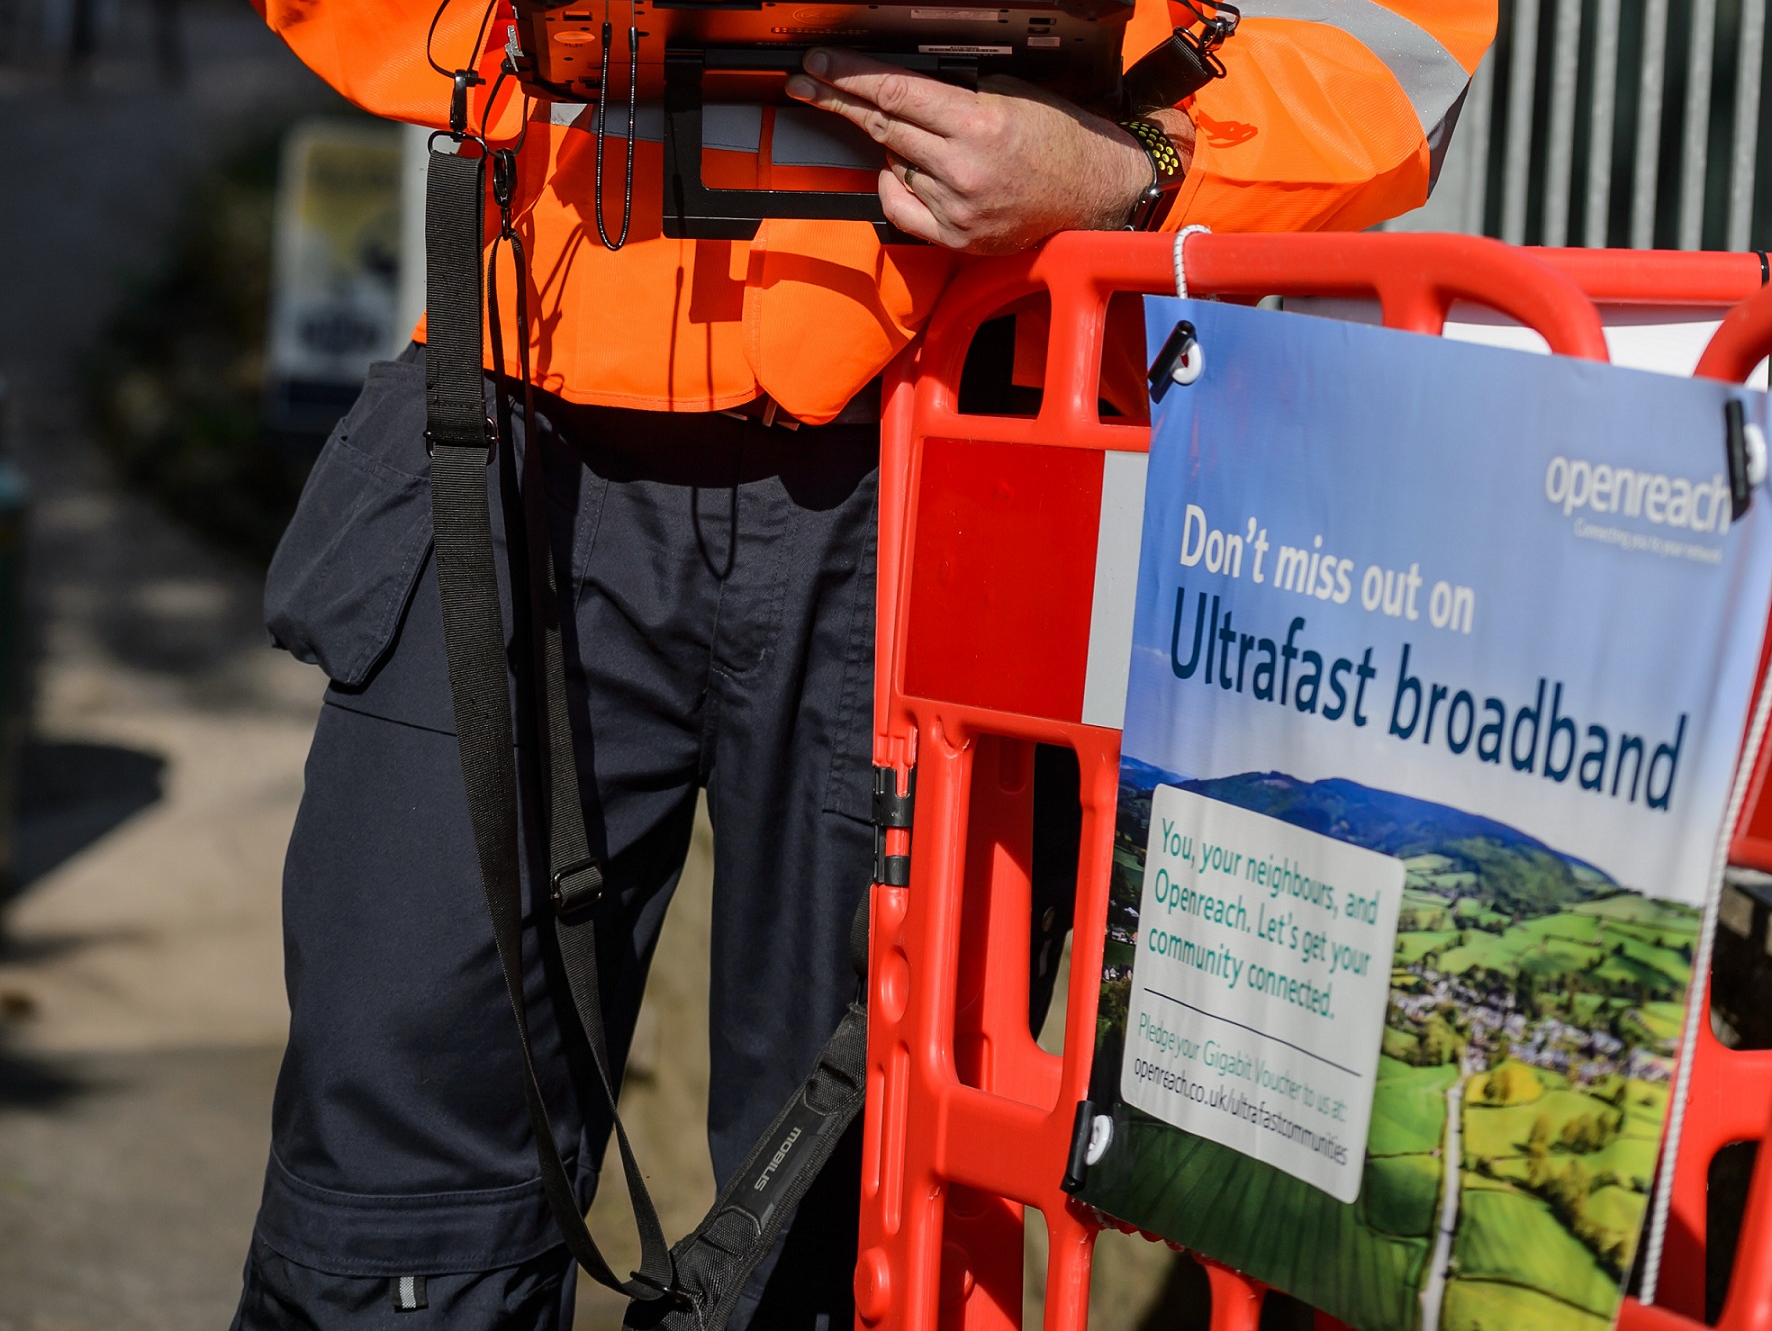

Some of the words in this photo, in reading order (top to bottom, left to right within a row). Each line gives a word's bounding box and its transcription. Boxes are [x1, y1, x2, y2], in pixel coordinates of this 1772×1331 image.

[1545, 455, 1732, 536] openreach
[1180, 503, 1270, 584] Don't
[1274, 534, 1352, 606] miss
[1361, 561, 1420, 621] out
[1430, 579, 1475, 635] on
[1169, 587, 1377, 728] Ultrafast
[1389, 643, 1690, 812] broadband
[1161, 817, 1195, 869] You,
[1199, 842, 1242, 877] your
[1246, 853, 1338, 920] neighbours,
[1345, 890, 1381, 925] and
[1155, 868, 1251, 934] Openreach.
[1258, 902, 1298, 951] Let's
[1302, 930, 1327, 963] get
[1329, 941, 1371, 977] your
[1149, 927, 1244, 989] community
[1247, 962, 1335, 1019] connected.
[1138, 1012, 1175, 1053] Pledge
[1175, 1037, 1200, 1061] your
[1202, 1040, 1253, 1081] Gigabit
[1254, 1057, 1303, 1101] Voucher
[754, 1126, 802, 1192] MOBILIS
